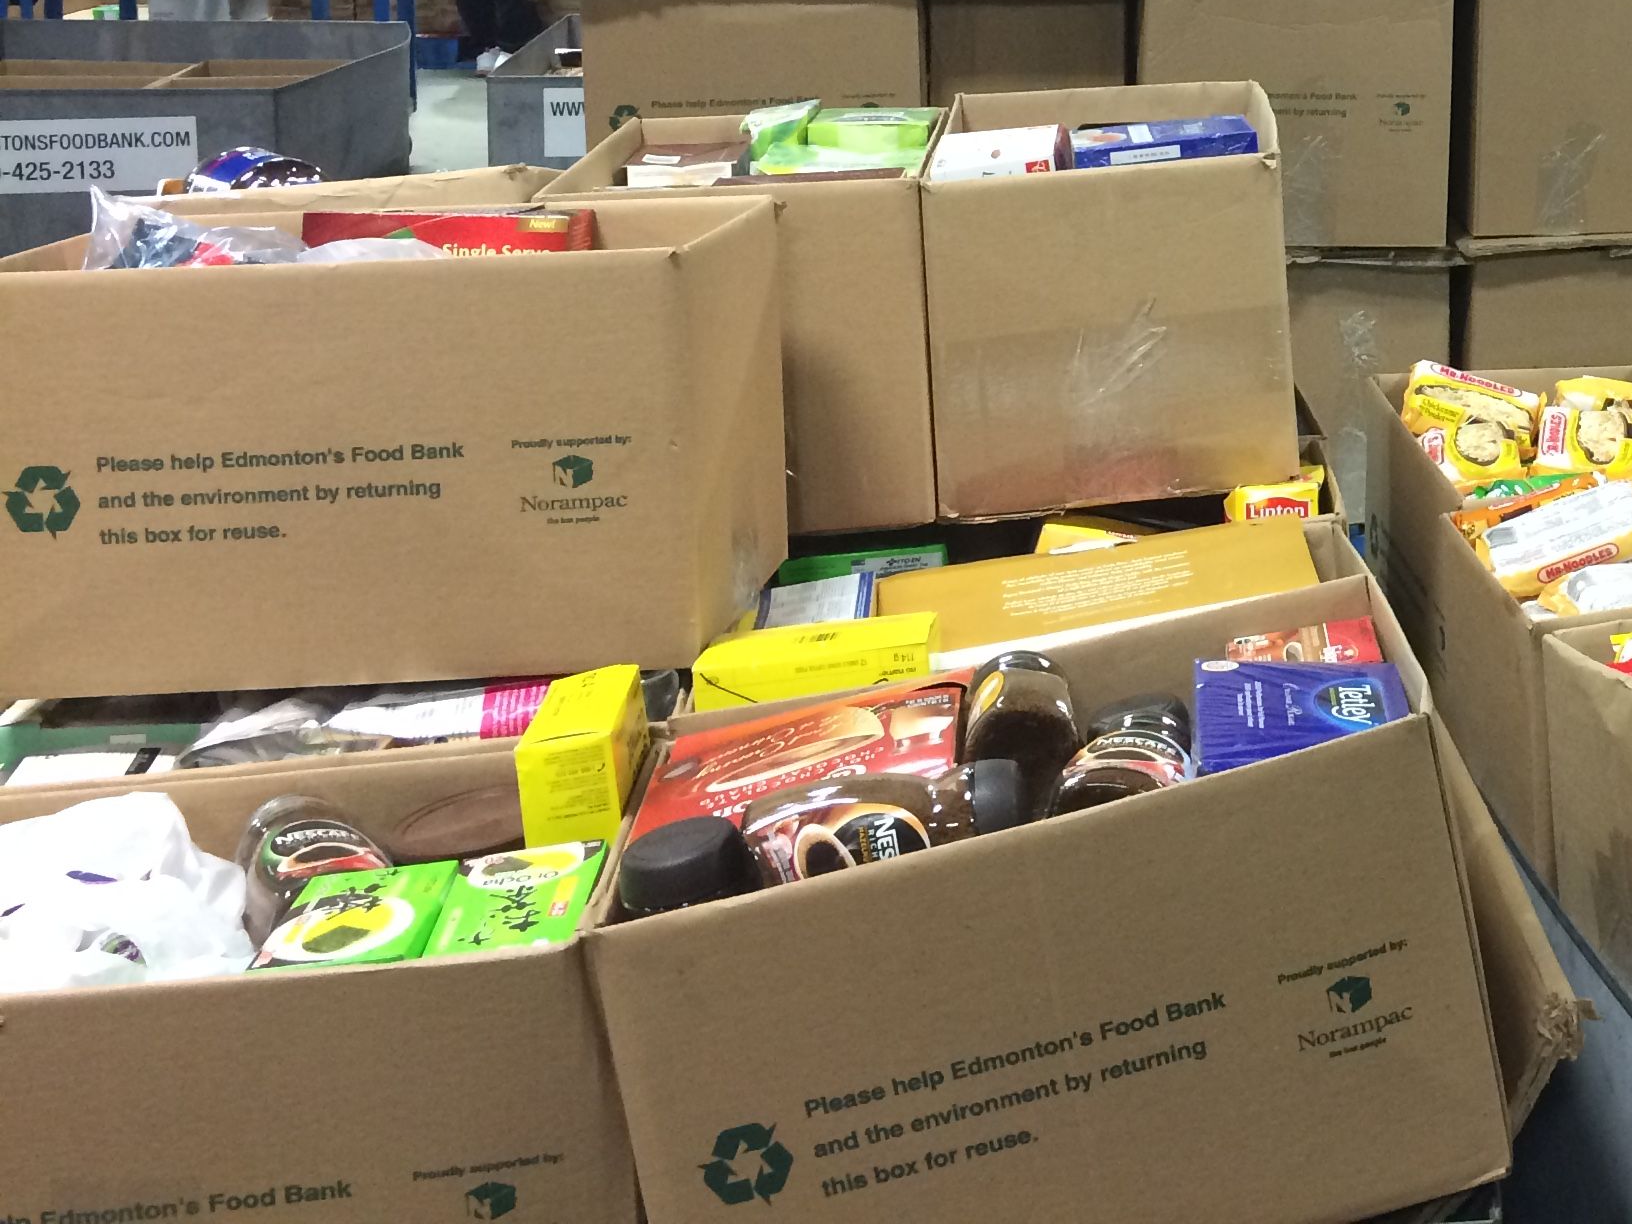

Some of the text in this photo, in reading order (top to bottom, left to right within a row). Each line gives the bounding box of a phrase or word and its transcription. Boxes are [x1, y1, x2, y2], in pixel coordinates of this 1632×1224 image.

[1, 131, 190, 151] TONSFOODBANK.COM
[529, 219, 556, 229] New!
[442, 244, 486, 257] Single
[512, 435, 632, 449] Proudly supported by:
[96, 442, 464, 473] Please help Edmonton's Food Bank
[98, 480, 441, 508] and the environment by returning
[520, 496, 628, 512] Norampac
[1250, 504, 1304, 518] Lipton
[99, 525, 287, 545] this box for reuse.
[1331, 685, 1375, 725] Tetley
[868, 829, 878, 858] RICH
[873, 816, 900, 860] NES
[1278, 939, 1407, 984] Proudly supported by:
[1298, 1006, 1413, 1051] Norampac
[804, 992, 1227, 1118] Please help Edmonton's Food Bank
[813, 1039, 1208, 1158] and the environment by returning
[822, 1129, 1039, 1198] this box for reuse.
[40, 1197, 199, 1224] Edmonton's
[209, 1188, 276, 1212] Food
[285, 1180, 352, 1204] Bank
